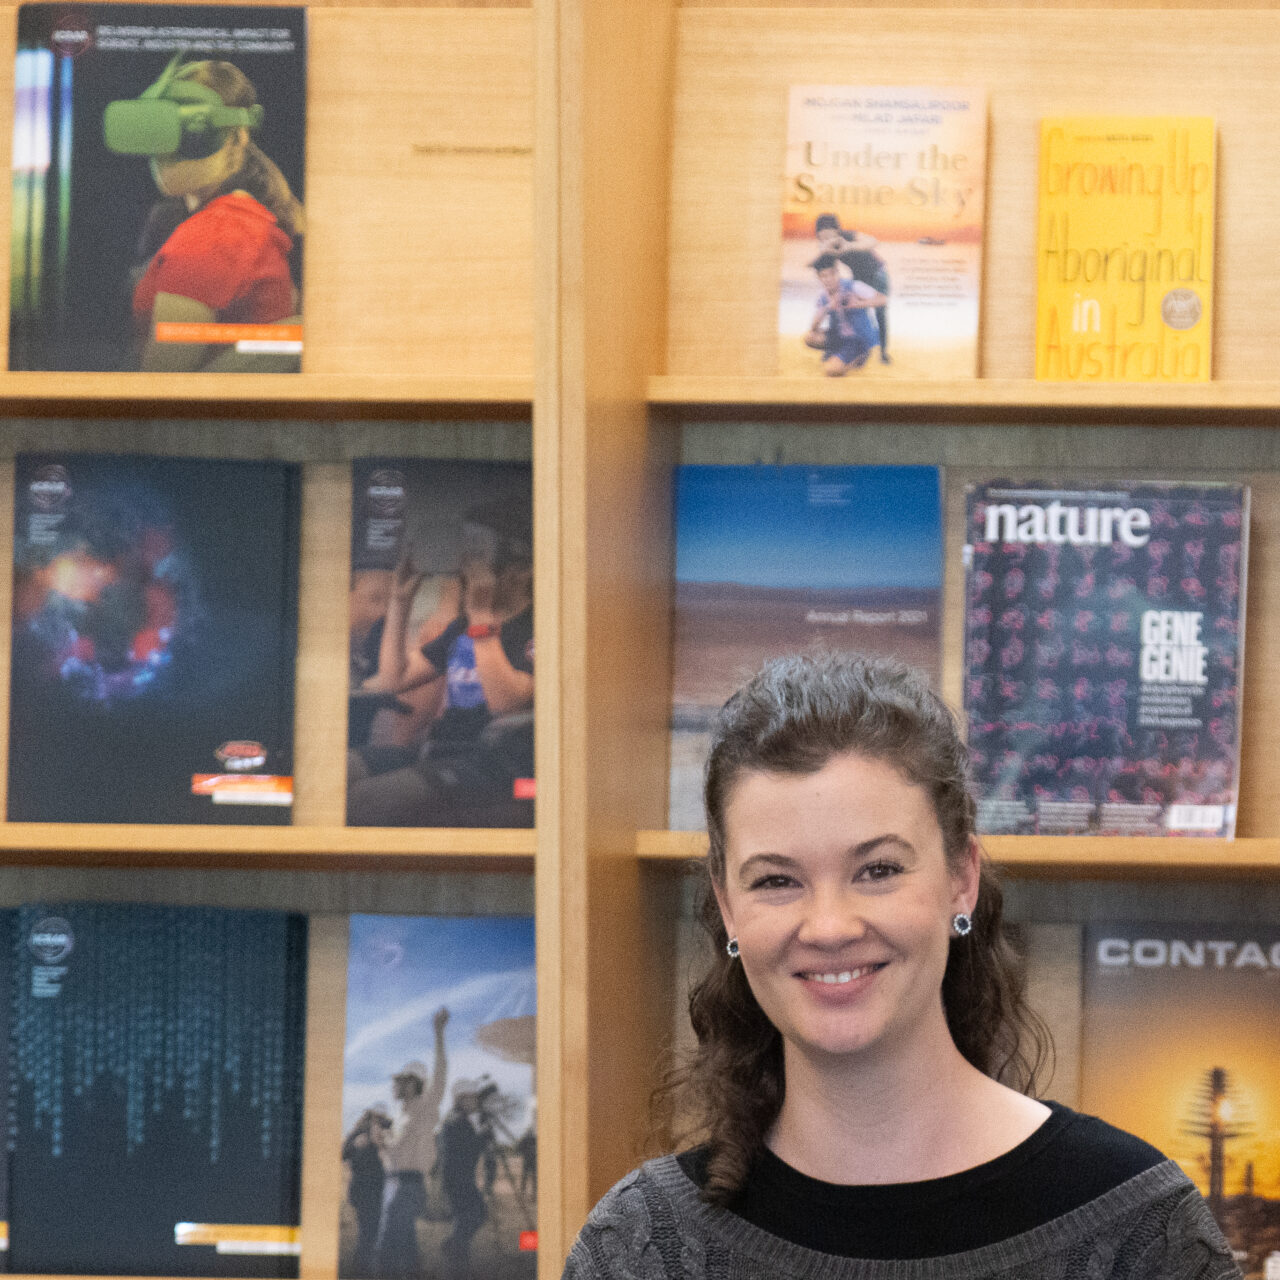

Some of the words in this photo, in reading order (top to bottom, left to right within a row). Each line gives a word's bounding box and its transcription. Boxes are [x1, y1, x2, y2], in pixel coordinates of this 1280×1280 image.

[803, 140, 909, 168] Under
[917, 143, 969, 171] the
[793, 173, 895, 205] Same
[907, 177, 974, 219] Sky
[1043, 211, 1211, 327] Aboriginal
[1071, 291, 1102, 334] in
[1043, 304, 1202, 380] Australia
[985, 500, 1151, 547] nature
[1140, 610, 1203, 646] GENE
[1139, 646, 1209, 684] GENIE
